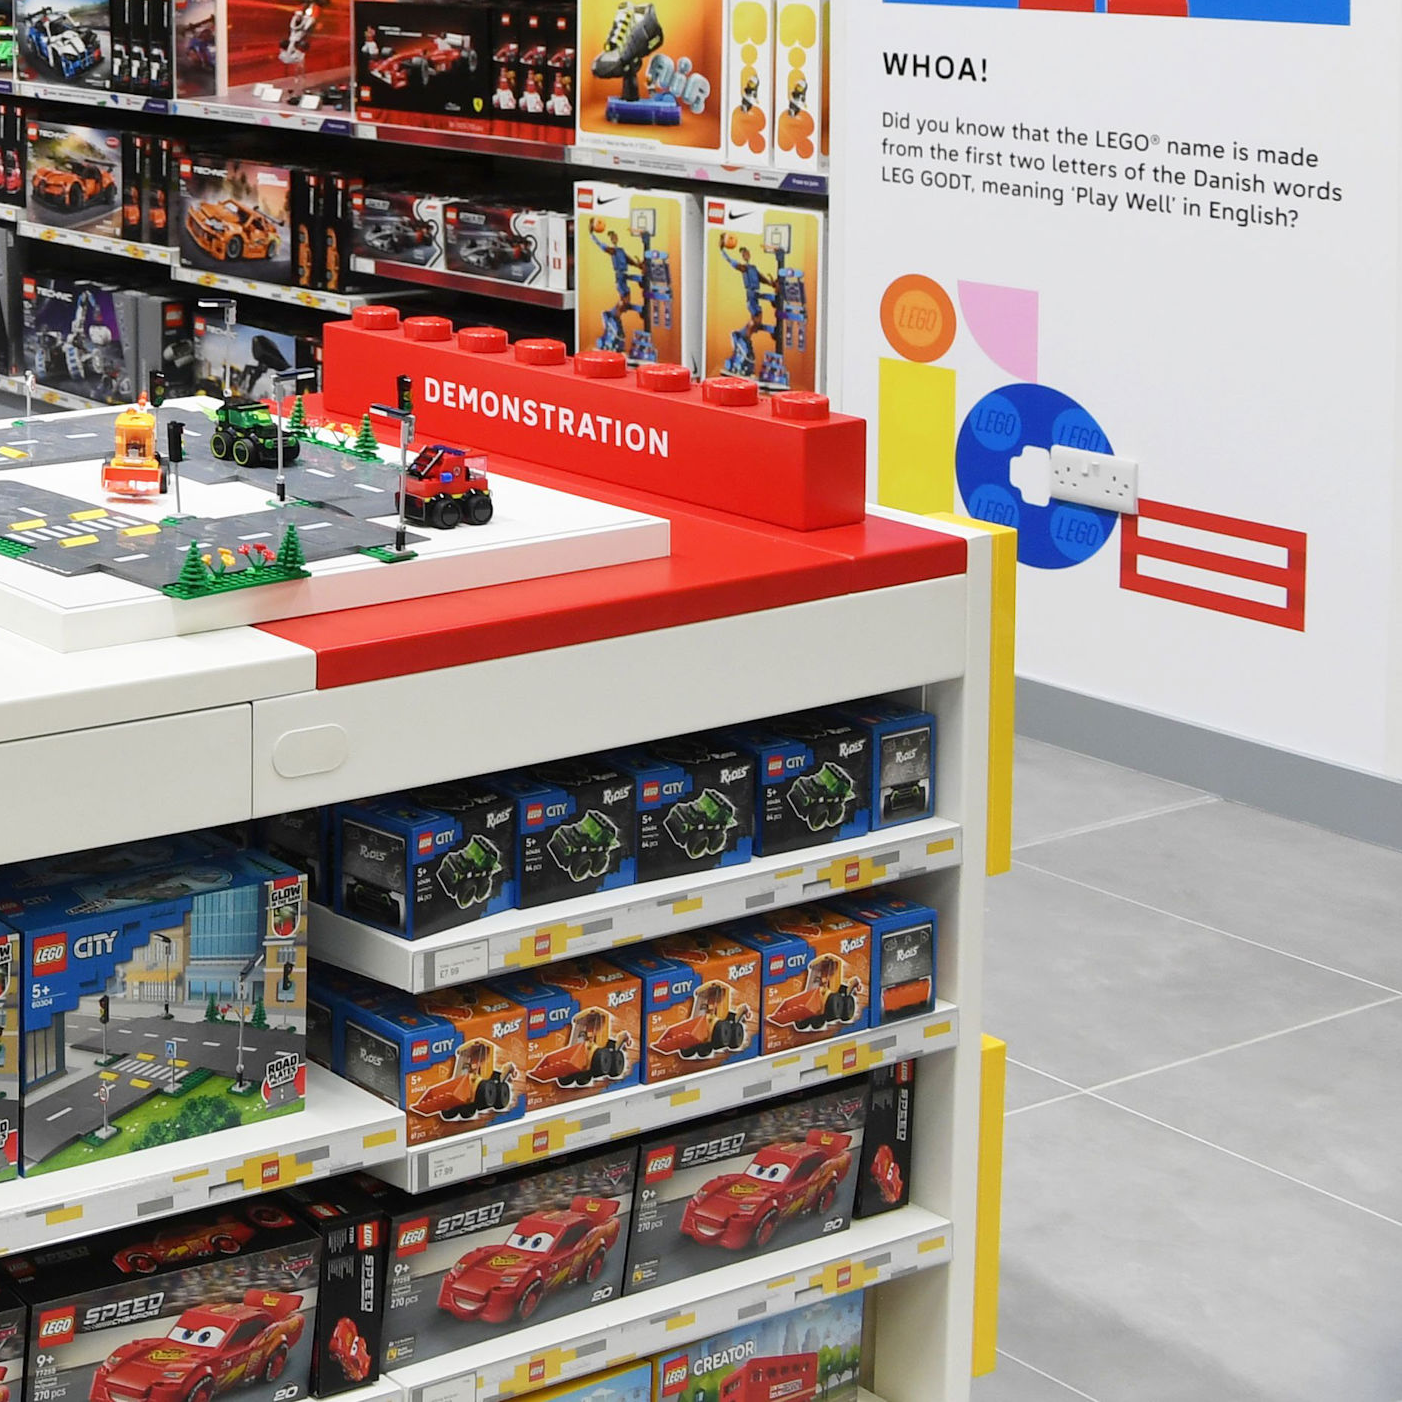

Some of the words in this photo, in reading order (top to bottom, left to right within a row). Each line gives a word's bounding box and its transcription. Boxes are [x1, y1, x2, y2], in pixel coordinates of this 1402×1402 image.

[882, 52, 989, 83] WHOA!
[39, 129, 69, 140] TECHNIC
[882, 111, 910, 129] Did
[916, 119, 949, 135] you
[956, 117, 1005, 138] know
[1012, 123, 1049, 142] that
[1056, 127, 1088, 146] the
[1167, 140, 1225, 159] name
[1233, 141, 1249, 161] is
[1257, 147, 1318, 168] made
[193, 166, 229, 178] TECHNIC
[882, 138, 923, 157] from
[930, 144, 959, 162] the
[966, 146, 1003, 166] first
[1009, 153, 1045, 171] two
[1052, 154, 1117, 178] letters
[1124, 163, 1146, 181] of
[1153, 165, 1186, 185] the
[1194, 169, 1265, 193] Danish
[1274, 181, 1342, 202] words
[882, 166, 914, 184] LEG
[920, 170, 975, 193] GODT,
[982, 179, 1063, 205] meaning
[1183, 197, 1201, 216] in
[1209, 201, 1299, 227] English?
[37, 287, 73, 303] TECHNIC
[898, 305, 938, 332] LEGO
[424, 375, 670, 460] DEMONSTRATION
[975, 408, 1016, 436] LEGO
[1056, 518, 1099, 547] LEGO
[786, 755, 805, 770] CITY
[644, 784, 659, 796] LEGO
[662, 780, 684, 796] CITY
[527, 809, 542, 819] LEGO
[546, 803, 567, 818] CITY
[641, 814, 653, 825] 5+
[418, 837, 433, 849] LEGO
[435, 830, 455, 845] CITY
[525, 837, 537, 848] 5+
[417, 868, 427, 878] 5+
[271, 885, 301, 903] GLOW
[35, 944, 65, 964] LEGO
[74, 930, 119, 959] CITY
[770, 960, 785, 970] LEGO
[787, 953, 808, 968] CITY
[31, 983, 50, 998] 5+
[653, 986, 669, 996] LEGO
[671, 980, 693, 995] CITY
[768, 988, 779, 997] 5+
[529, 1013, 545, 1024] LEGO
[549, 1006, 571, 1022] CITY
[651, 1014, 663, 1025] 5+
[412, 1046, 428, 1058] LEGO
[432, 1038, 455, 1054] CITY
[528, 1042, 539, 1052] 5+
[268, 1056, 297, 1076] ROAD
[359, 1048, 385, 1067] RIDES
[268, 1066, 297, 1083] PLATES
[410, 1075, 422, 1085] 5+
[896, 1088, 909, 1141] SPEED
[647, 1156, 672, 1173] LEGO
[680, 1132, 746, 1166] SPEED
[641, 1189, 657, 1203] 9+
[399, 1229, 426, 1246] LEGO
[435, 1201, 505, 1236] SPEED
[394, 1262, 410, 1276] 9+
[360, 1254, 375, 1313] SPEED
[390, 1298, 404, 1309] 270
[404, 1295, 419, 1308] pcs
[591, 1286, 613, 1303] 20
[41, 1318, 72, 1337] LEGO
[83, 1291, 165, 1325] SPEED
[36, 1354, 55, 1368] 9+
[664, 1367, 688, 1386] LEGO
[693, 1340, 756, 1377] CREATOR
[33, 1389, 50, 1401] 270
[50, 1387, 66, 1400] pcs
[273, 1385, 299, 1402] 20
